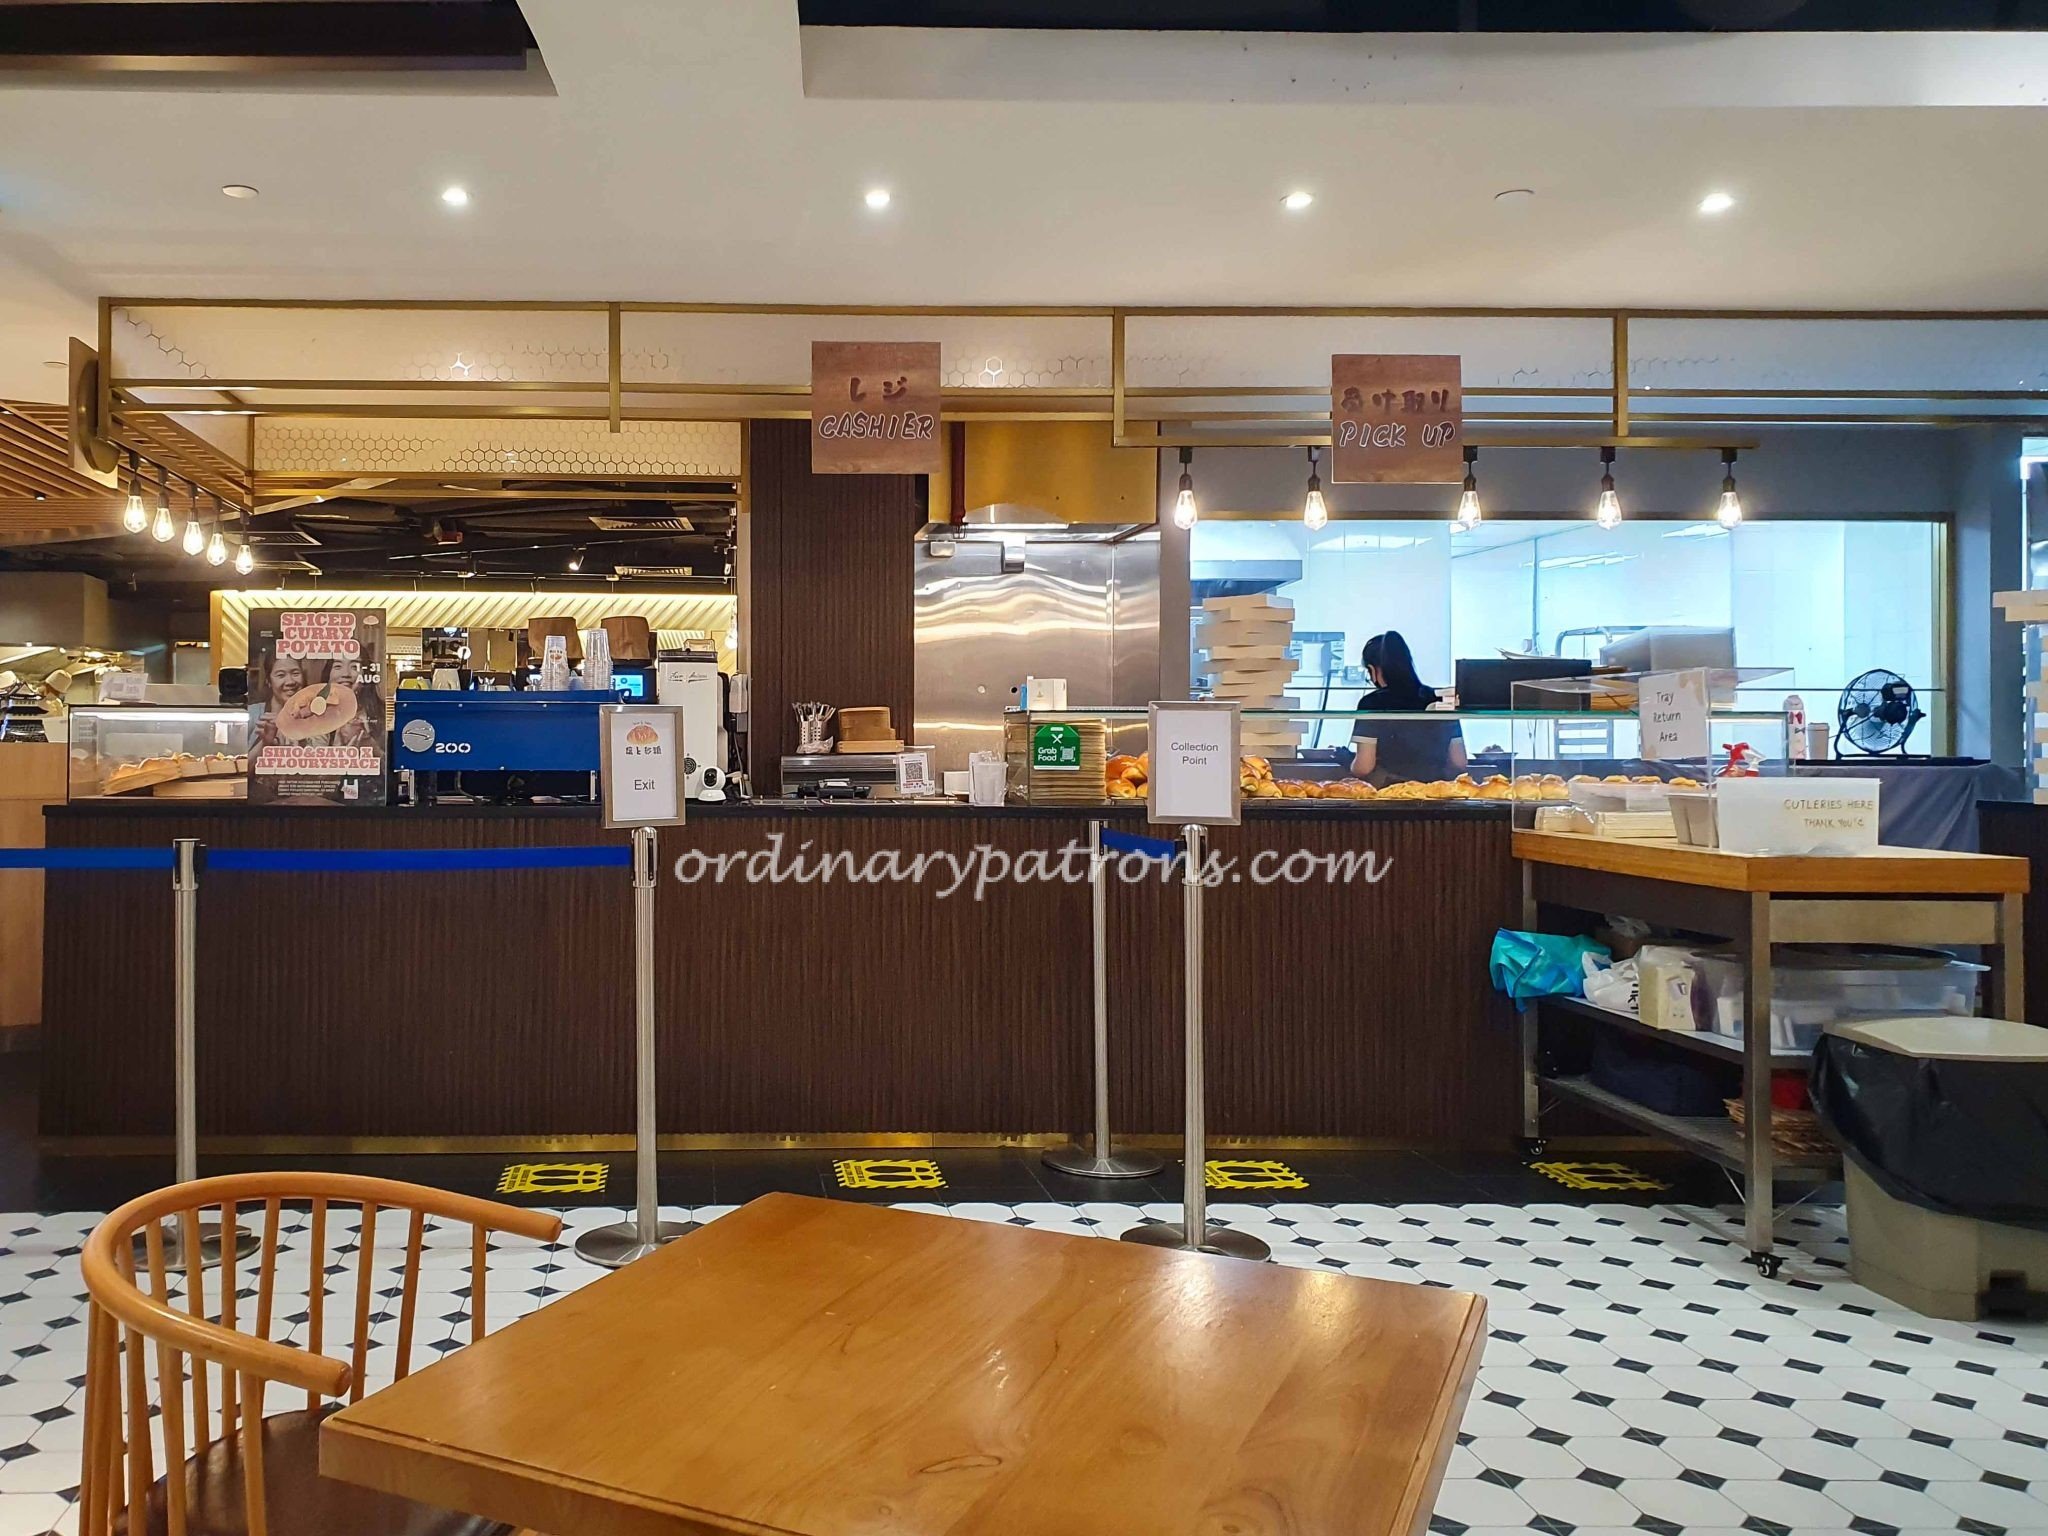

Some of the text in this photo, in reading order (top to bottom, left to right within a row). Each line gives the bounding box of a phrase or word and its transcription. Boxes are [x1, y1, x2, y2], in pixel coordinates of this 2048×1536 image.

[819, 410, 935, 440] CASHIER
[1339, 420, 1456, 448] PICK UP
[281, 612, 356, 628] SPICED
[284, 626, 353, 640] CURRY
[276, 639, 360, 655] POTATO
[355, 674, 381, 684] AUG
[1656, 691, 1674, 706] Tray
[1653, 711, 1682, 723] Return
[1659, 731, 1678, 742] Area
[263, 747, 356, 758] SHIO&SATO
[435, 742, 471, 754] 200
[1037, 747, 1058, 755] Grab
[1170, 741, 1219, 752] Collection
[256, 757, 380, 769] AFLOURYSPACE
[1037, 754, 1058, 762] Food
[1182, 755, 1207, 766] Point
[634, 779, 655, 791] Exit
[1783, 799, 1874, 810] CUTLERIES HERE
[1804, 818, 1835, 829] THANK
